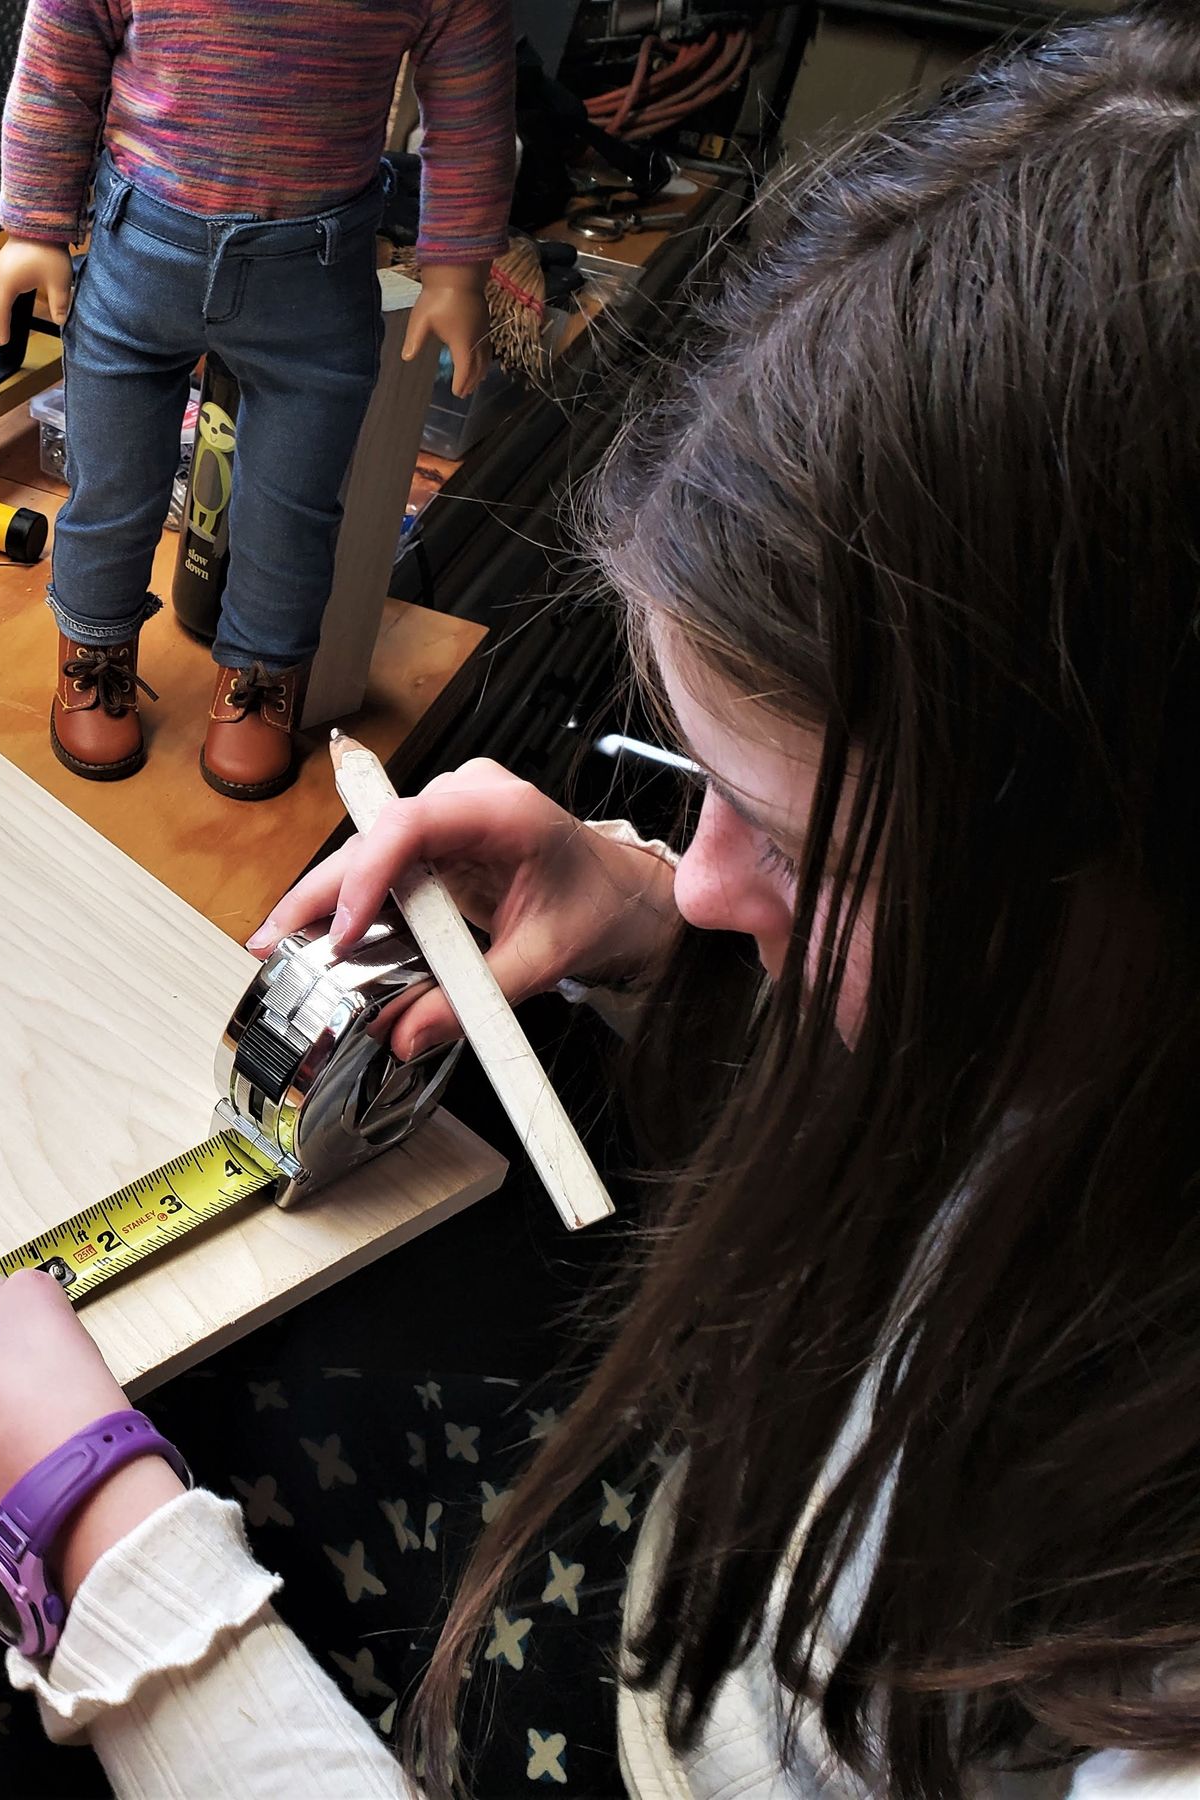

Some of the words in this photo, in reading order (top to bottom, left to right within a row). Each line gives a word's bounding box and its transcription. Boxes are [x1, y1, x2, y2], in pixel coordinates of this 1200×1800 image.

[188, 549, 208, 566] slow
[185, 558, 209, 580] down
[225, 1159, 243, 1178] 4
[159, 1194, 183, 1215] 3
[121, 1210, 157, 1234] STANLEY
[77, 1229, 89, 1243] ft
[96, 1230, 122, 1253] 2
[28, 1245, 39, 1260] 1
